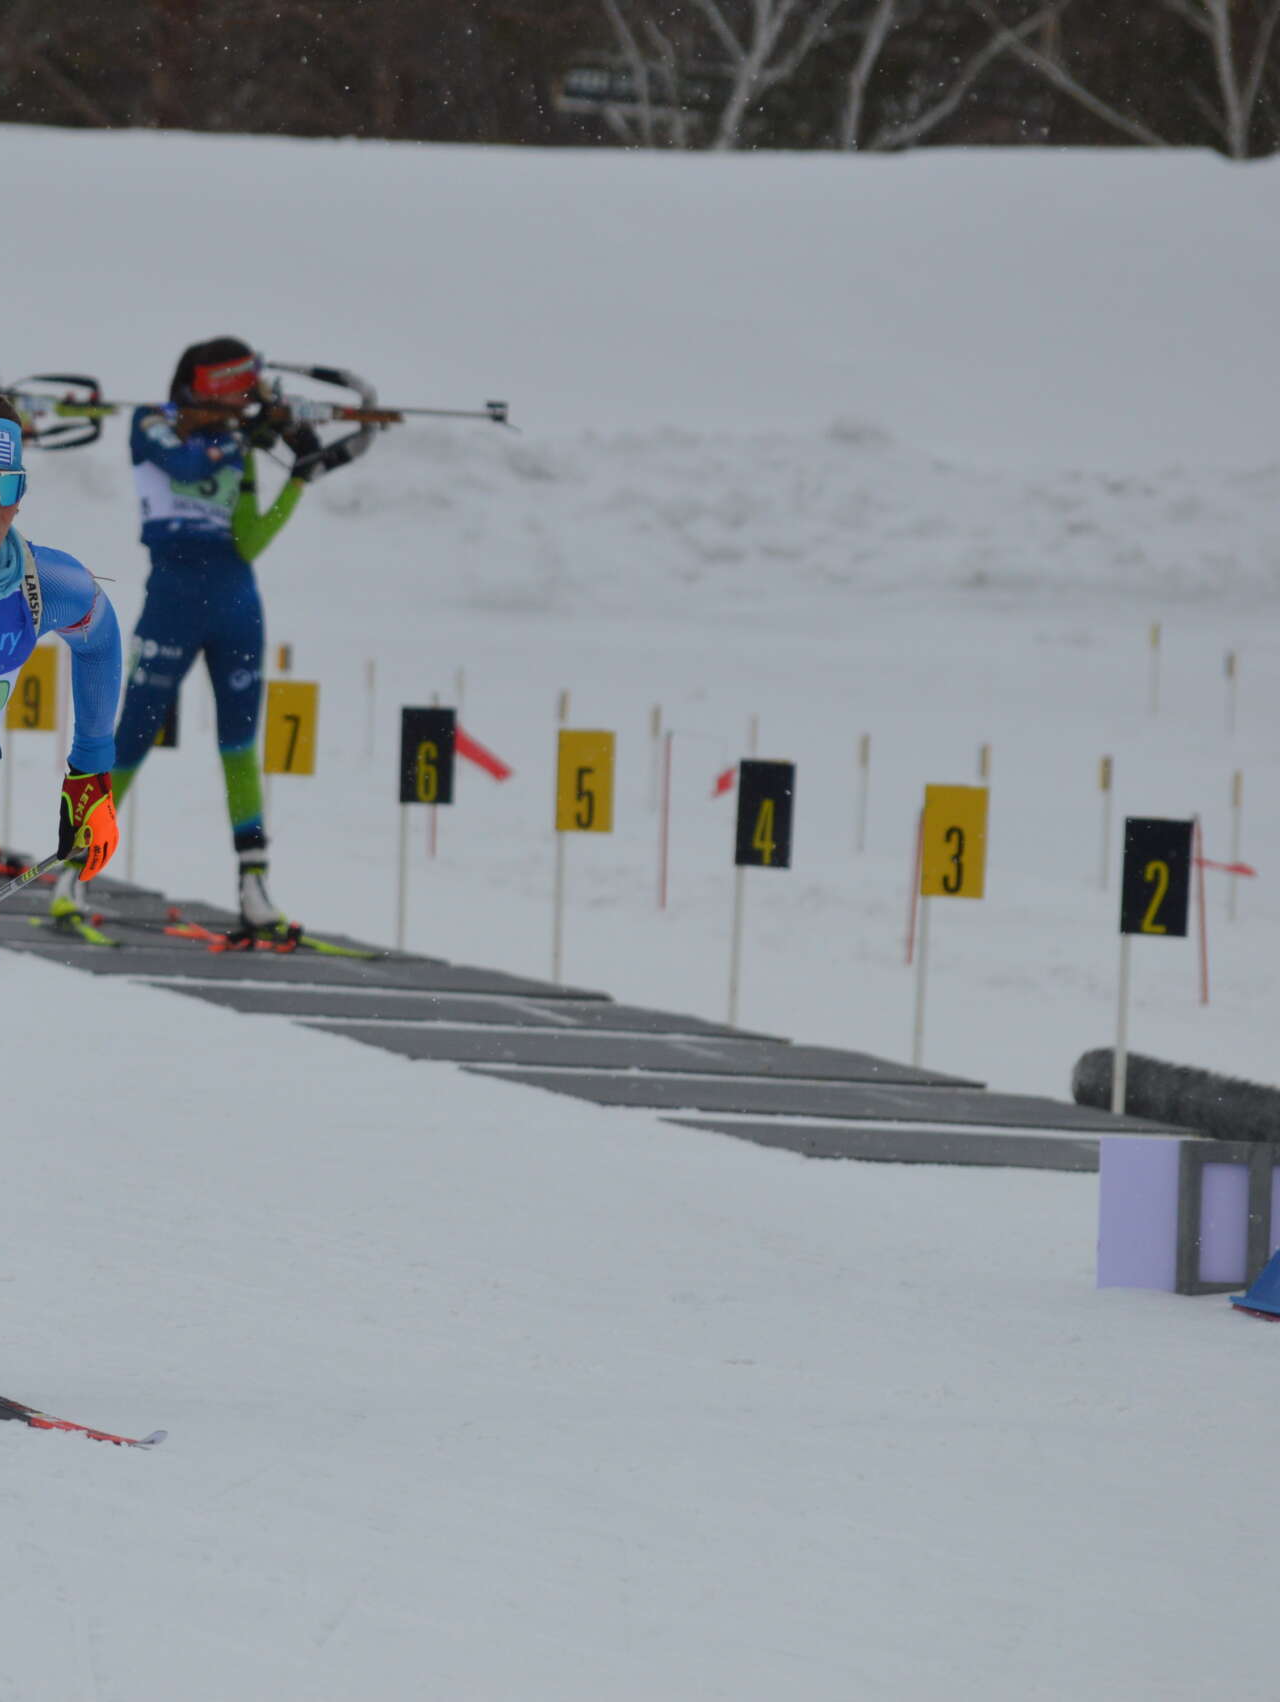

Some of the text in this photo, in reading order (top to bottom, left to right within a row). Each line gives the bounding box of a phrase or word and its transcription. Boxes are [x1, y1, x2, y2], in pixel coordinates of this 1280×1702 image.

[23, 676, 41, 728] 9
[282, 713, 301, 772] 7
[415, 741, 439, 803] 6
[74, 783, 94, 822] LEKI
[575, 767, 596, 830] 5
[752, 798, 776, 865] 4
[942, 826, 966, 894] 3
[1140, 860, 1171, 933] 2
